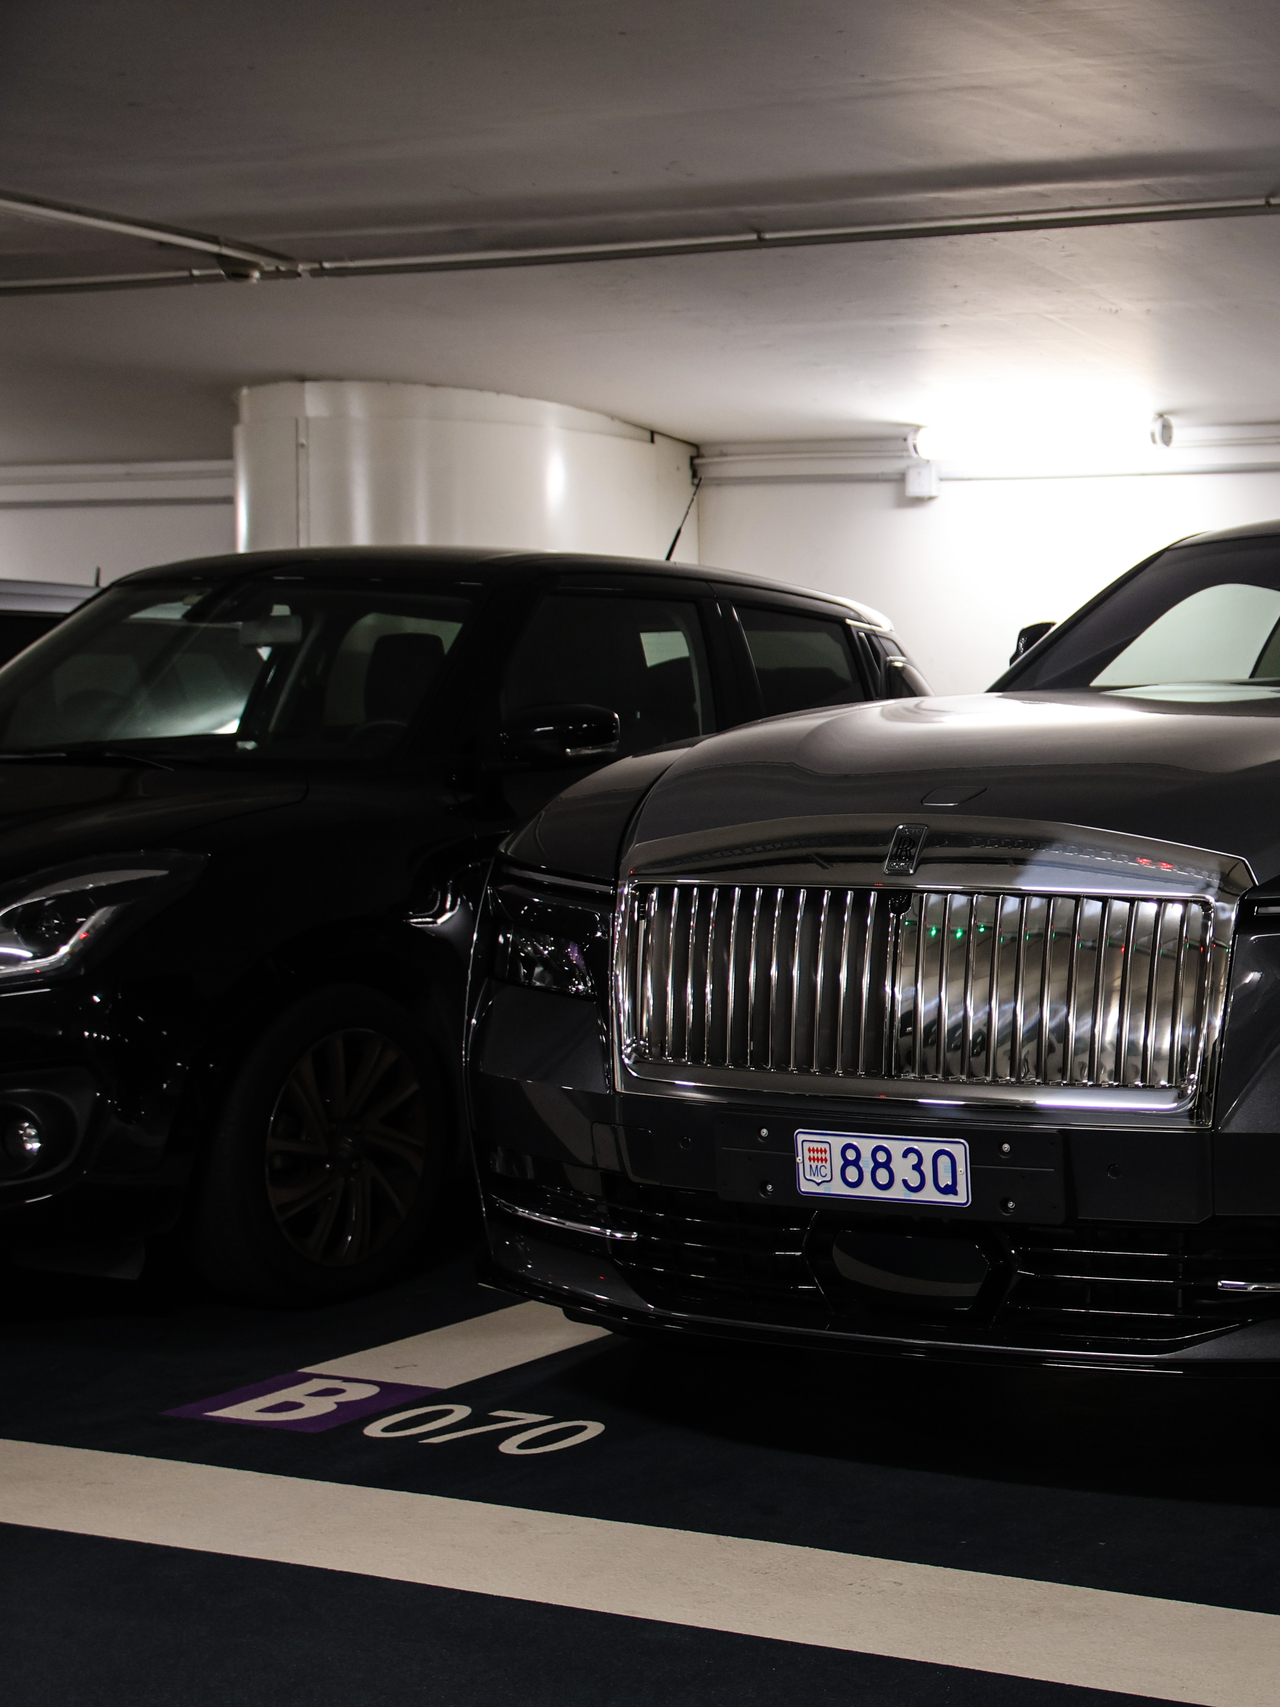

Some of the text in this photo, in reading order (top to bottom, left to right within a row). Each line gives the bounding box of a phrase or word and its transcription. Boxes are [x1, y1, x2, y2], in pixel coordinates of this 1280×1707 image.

[809, 1142, 959, 1196] MC 883Q
[203, 1377, 606, 1455] B 070
